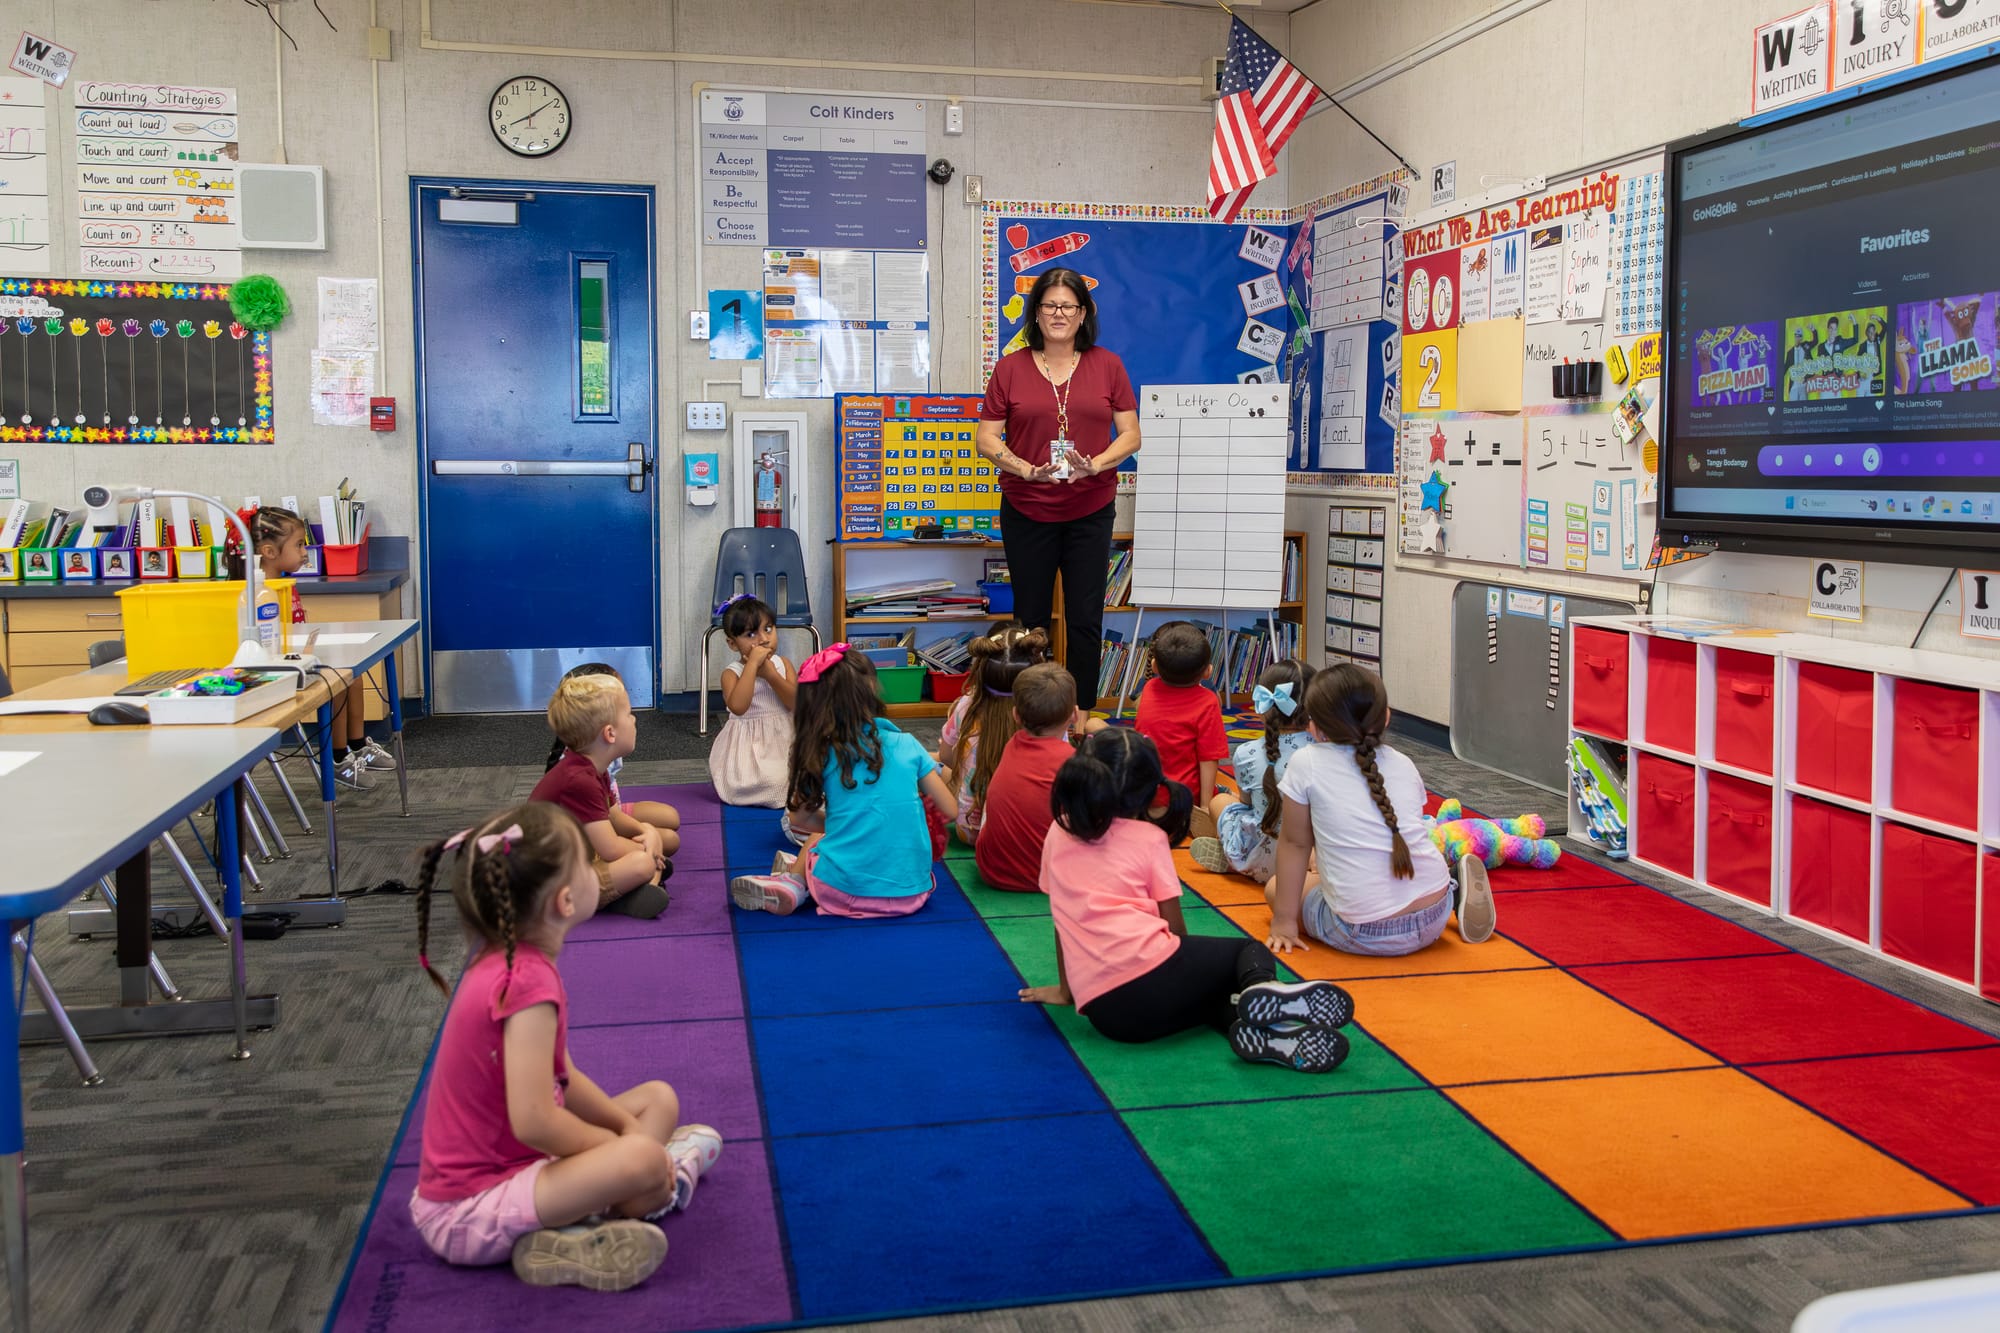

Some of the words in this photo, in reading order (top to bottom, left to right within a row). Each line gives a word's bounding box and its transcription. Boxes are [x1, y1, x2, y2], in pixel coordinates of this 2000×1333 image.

[1927, 14, 2000, 49] COLLABORATI
[25, 36, 52, 61] W
[1762, 25, 1795, 73] W
[1843, 34, 1906, 75] INQUIRY
[18, 57, 58, 80] WRITING
[511, 85, 520, 95] 11
[525, 81, 536, 91] 12
[543, 86, 547, 96] 1
[1761, 69, 1817, 101] WRITING
[86, 84, 148, 107] Counting
[155, 86, 222, 109] Strategies
[498, 95, 508, 105] 10
[553, 98, 560, 108] 2
[495, 110, 502, 120] 9
[558, 113, 565, 123] 3
[810, 105, 839, 118] Colt
[843, 107, 895, 120] Kinders
[82, 114, 111, 127] Count
[117, 117, 133, 129] out
[139, 118, 161, 130] loud
[500, 125, 507, 135] 8
[553, 128, 560, 137] 4
[513, 137, 520, 147] 7
[527, 141, 534, 151] 6
[543, 138, 549, 148] 5
[783, 135, 804, 143] Carpet
[82, 144, 111, 156] Touch
[116, 145, 134, 157] and
[139, 146, 169, 157] count
[716, 151, 753, 165] Accept
[1901, 157, 1928, 170] Holidays
[1936, 149, 1966, 162] Routines
[83, 173, 110, 185] Move
[116, 173, 134, 185] and
[140, 174, 169, 185] count
[709, 168, 759, 178] Responsibility
[1870, 165, 1897, 178] Learning
[1434, 168, 1443, 191] R
[726, 184, 743, 198] Be
[83, 200, 105, 212] Line
[110, 202, 122, 214] up
[126, 200, 144, 212] and
[148, 201, 176, 212] count
[713, 199, 758, 209] Respectful
[1403, 223, 1445, 258] What
[1447, 216, 1472, 246] We
[1475, 207, 1511, 240] Are
[1516, 173, 1620, 229] Learning
[717, 217, 754, 231] Choose
[1573, 220, 1600, 242] Elliot
[86, 227, 114, 240] Count
[120, 230, 132, 240] on
[719, 232, 757, 241] Kindness
[1249, 229, 1269, 250] W
[1860, 228, 1930, 254] Favorites
[1039, 243, 1056, 258] red
[1244, 247, 1275, 265] WRITING
[90, 254, 136, 269] Recount
[1571, 250, 1599, 275] Sophia
[1567, 272, 1590, 296] Owen
[1857, 280, 1878, 288] Videos
[1902, 272, 1930, 281] Activities
[1247, 282, 1259, 300] I
[1387, 286, 1395, 307] C
[1250, 293, 1279, 310] INQUIRY
[1248, 324, 1265, 343] C
[1526, 343, 1557, 361] Michelle
[1925, 339, 1940, 351] THE
[1920, 339, 1979, 374] LLAMA
[1639, 360, 1661, 377] SCHO
[1951, 357, 1989, 382] SONG
[1417, 345, 1442, 408] 2
[1699, 369, 1733, 395] PIZZA
[1734, 366, 1766, 391] MAN
[1807, 374, 1859, 392] MEATBALL
[1176, 392, 1218, 407] Letter
[1384, 387, 1394, 411] R
[1894, 400, 1905, 408] The
[1906, 399, 1925, 408] Llama
[1926, 399, 1943, 408] Song
[853, 409, 874, 417] January
[928, 406, 960, 414] September
[1331, 400, 1344, 417] cat
[852, 419, 874, 427] February
[1542, 429, 1553, 457] 5
[1580, 428, 1589, 459] 4
[1706, 459, 1723, 468] Tangy
[1724, 458, 1748, 468] Bodangy
[1868, 454, 1874, 464] 4
[858, 473, 869, 481] July
[853, 484, 873, 492] August
[1816, 562, 1837, 596] C
[1973, 575, 1989, 610] I
[1811, 600, 1860, 613] COLLABORATION
[1970, 614, 2000, 630] INQUI
